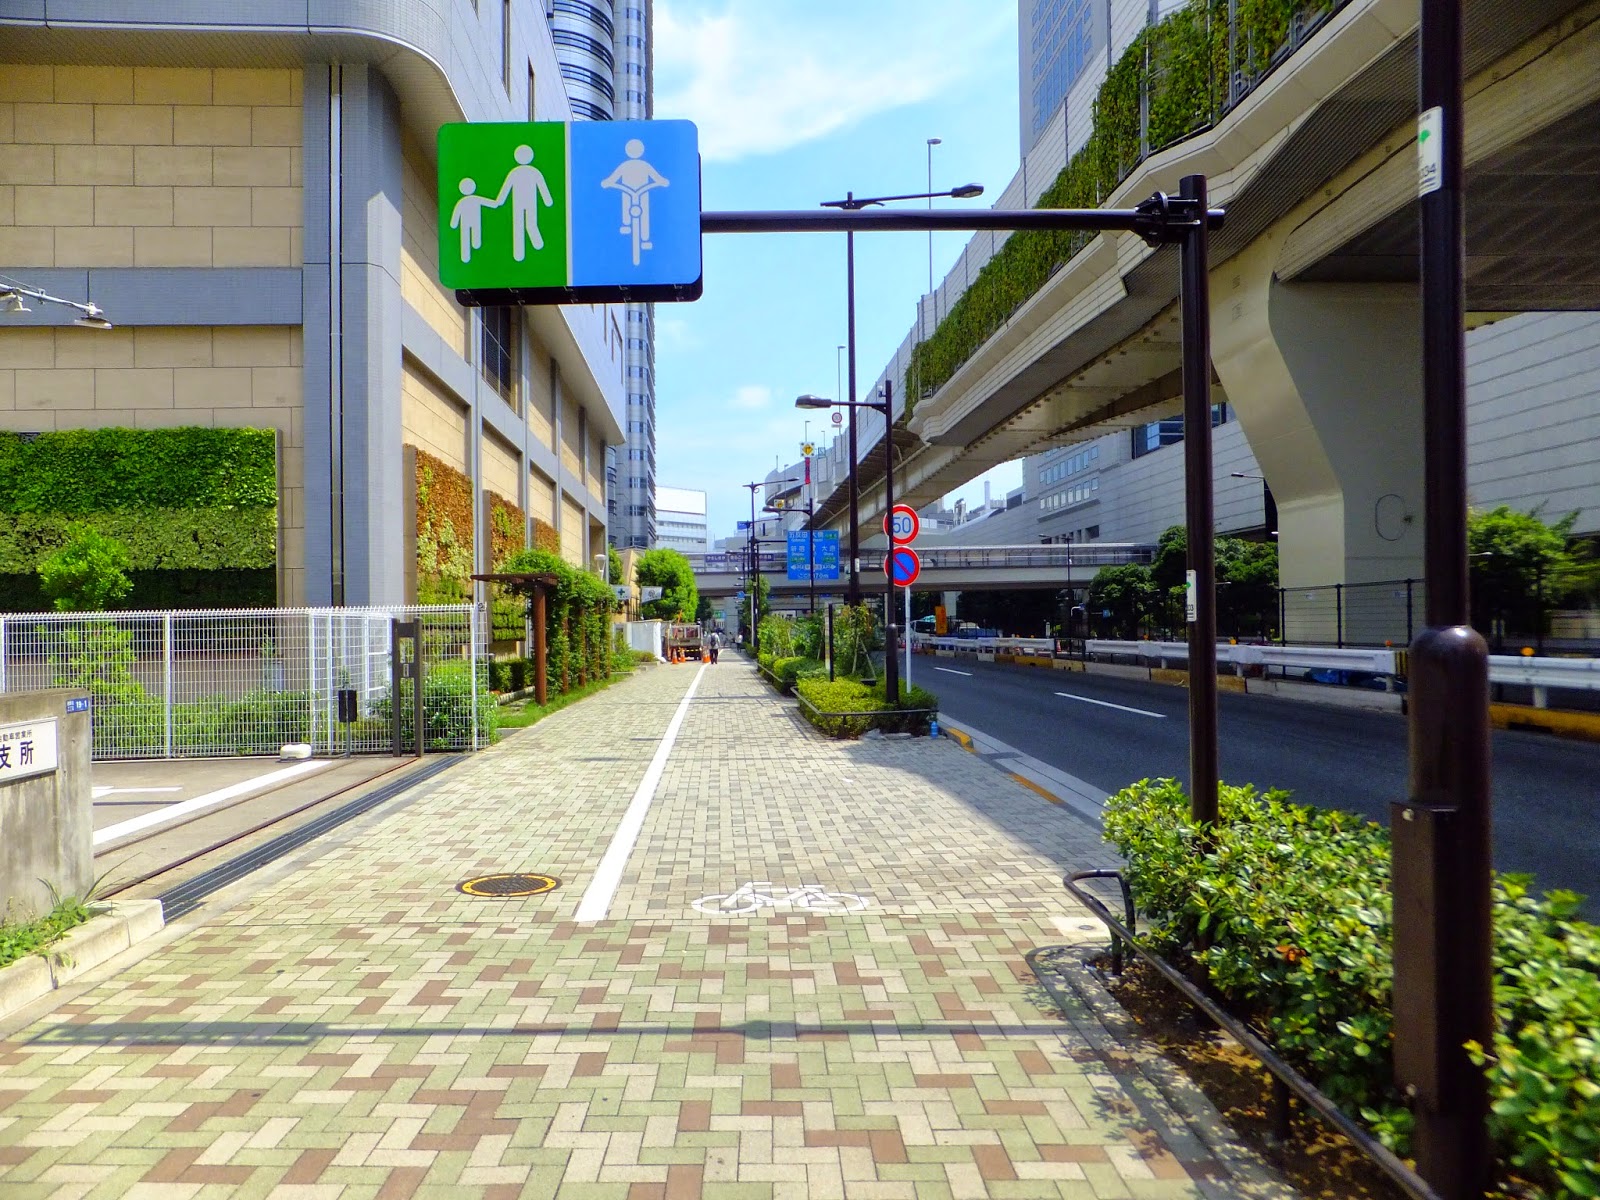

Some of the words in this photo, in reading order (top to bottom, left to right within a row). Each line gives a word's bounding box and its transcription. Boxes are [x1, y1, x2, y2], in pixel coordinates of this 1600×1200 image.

[892, 516, 911, 534] 50
[75, 700, 88, 709] 19-1
[0, 730, 32, 743] 動車営業所
[0, 740, 34, 769] 支所
